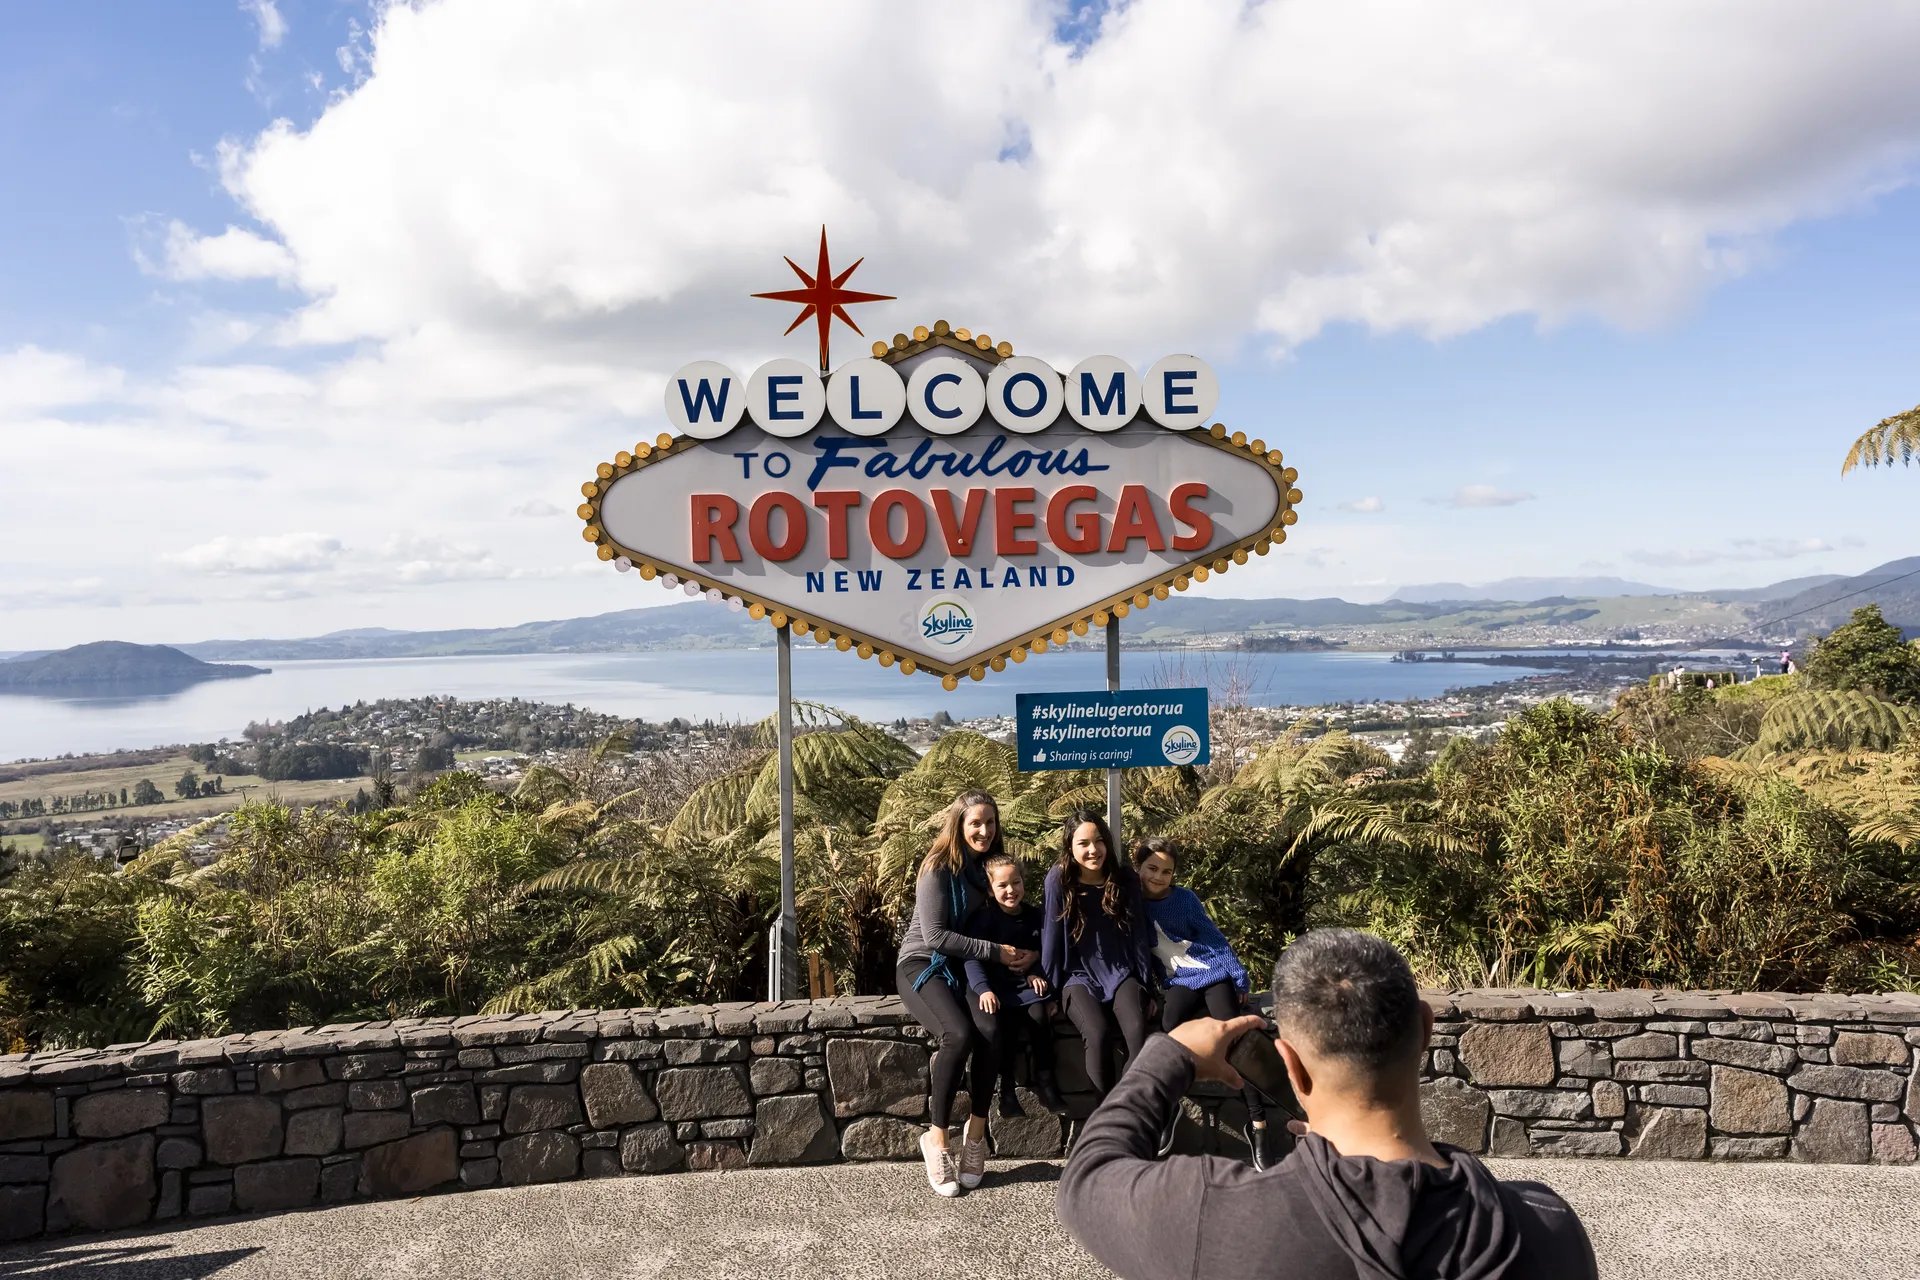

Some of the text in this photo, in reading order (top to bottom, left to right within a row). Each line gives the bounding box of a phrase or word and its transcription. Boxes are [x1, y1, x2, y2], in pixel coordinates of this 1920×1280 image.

[677, 371, 1199, 423] WELCOME
[734, 435, 1110, 492] TO Fabulous
[691, 483, 1215, 564] ROTOVEGAS
[806, 565, 1076, 593] NEW ZEALAND
[922, 610, 974, 638] Skyline
[1032, 702, 1184, 722] #skylinelugerotorua
[1032, 724, 1152, 743] #skylinerotorua
[1164, 736, 1198, 755] Skyline
[1049, 748, 1133, 763] Sharing is caring!
